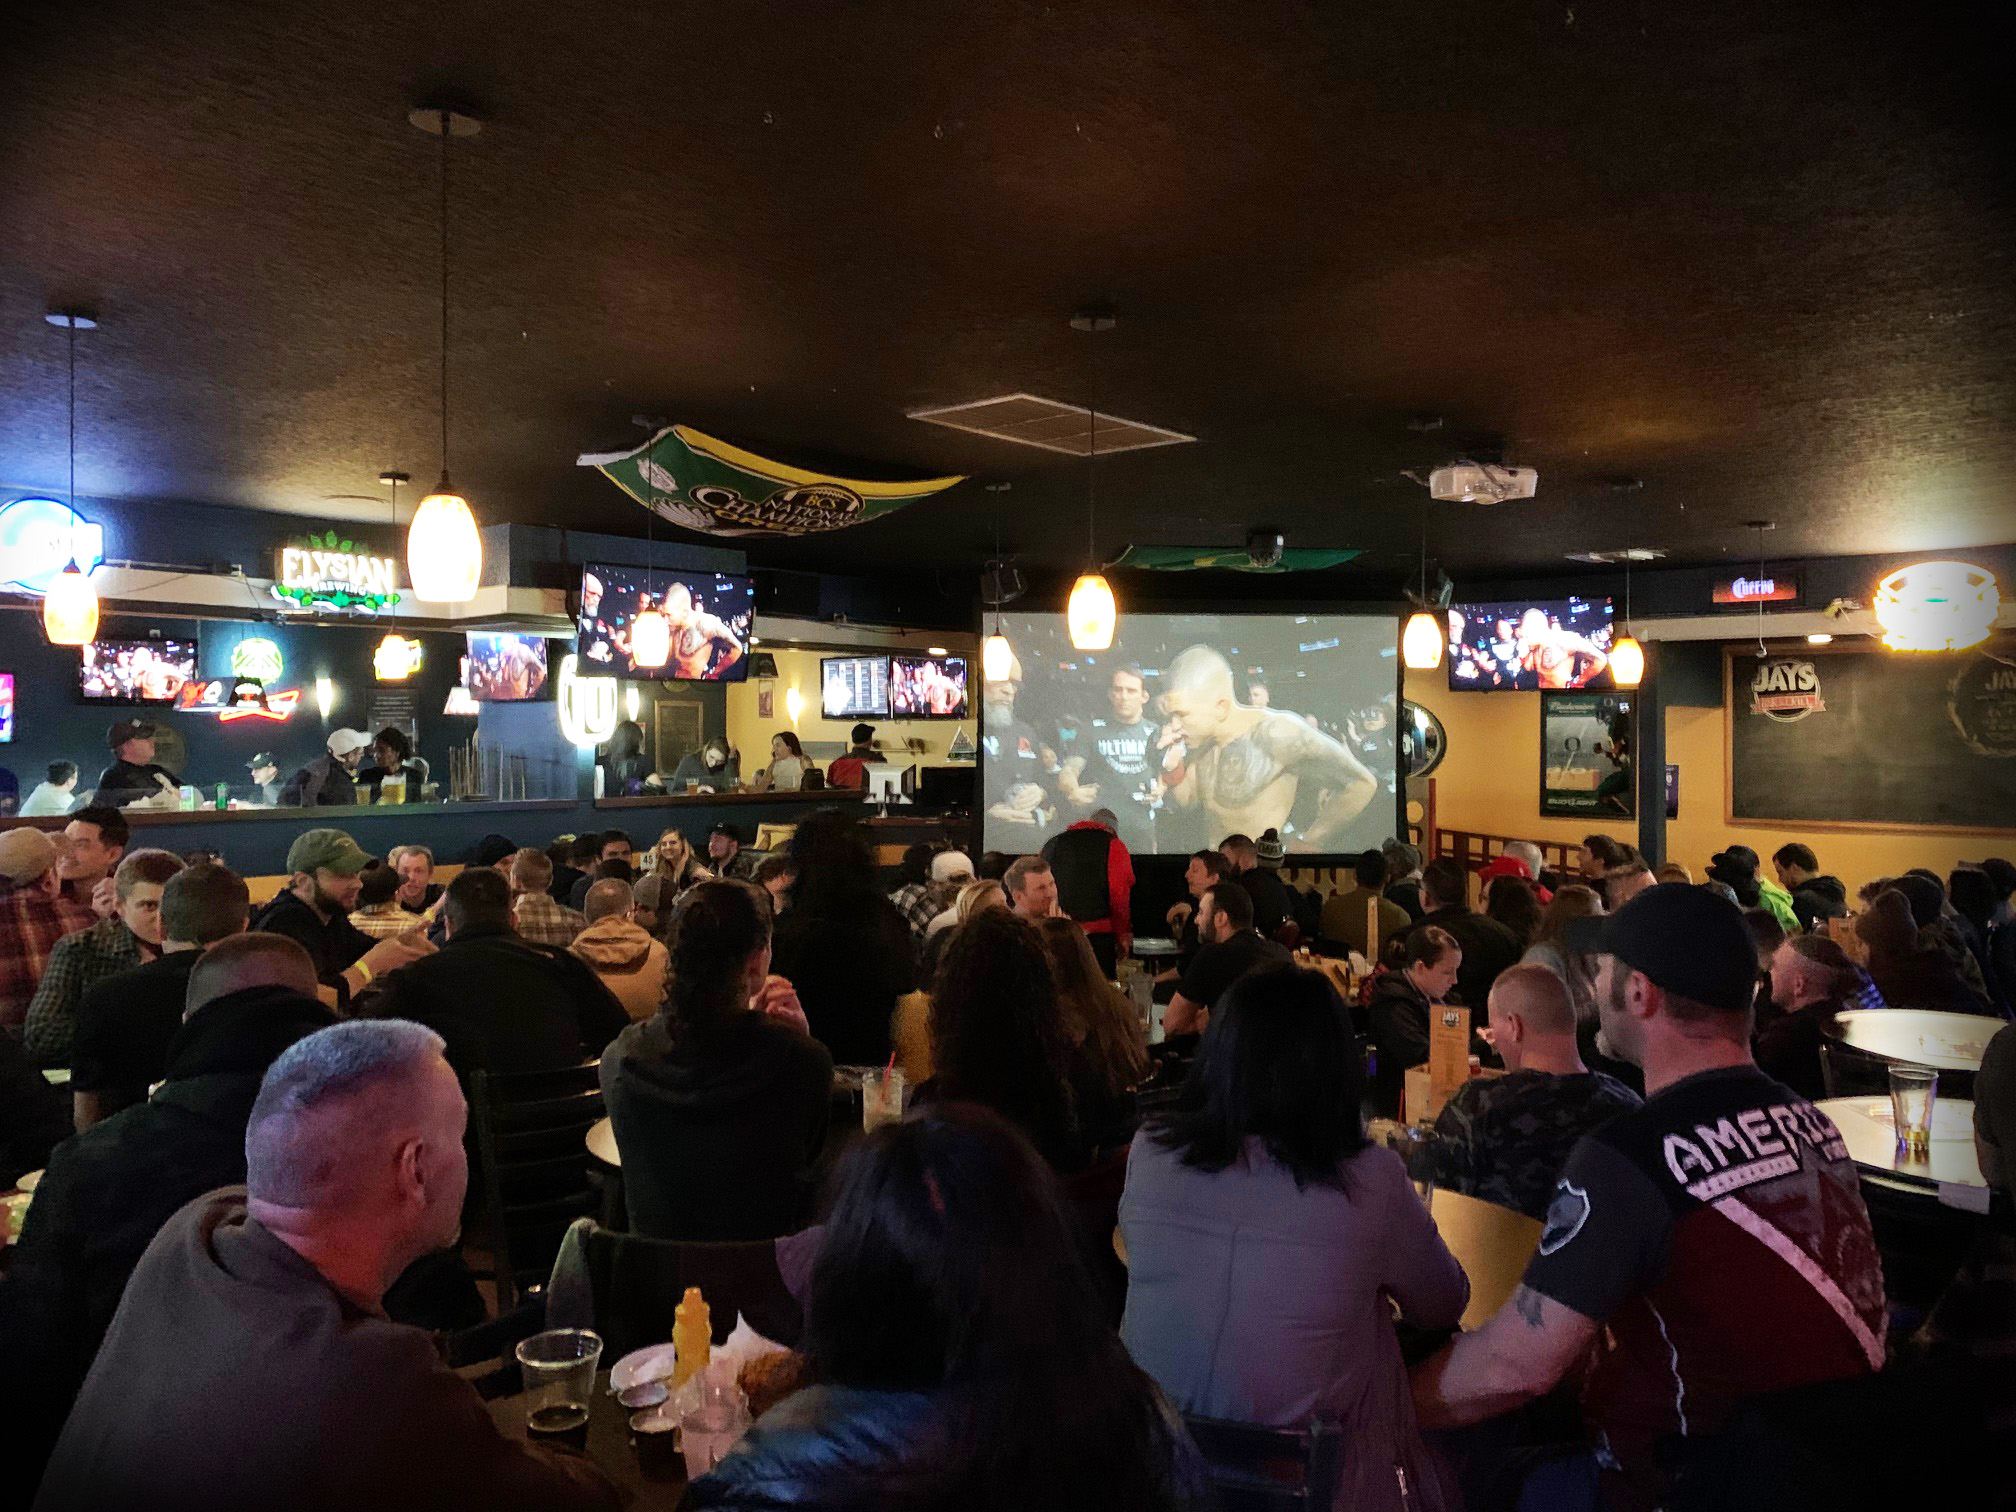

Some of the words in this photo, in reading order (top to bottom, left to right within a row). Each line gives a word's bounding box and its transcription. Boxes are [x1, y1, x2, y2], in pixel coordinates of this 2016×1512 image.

[282, 548, 394, 596] ELYSIAN
[311, 580, 367, 597] BREWING
[1754, 663, 1816, 692] JAYS
